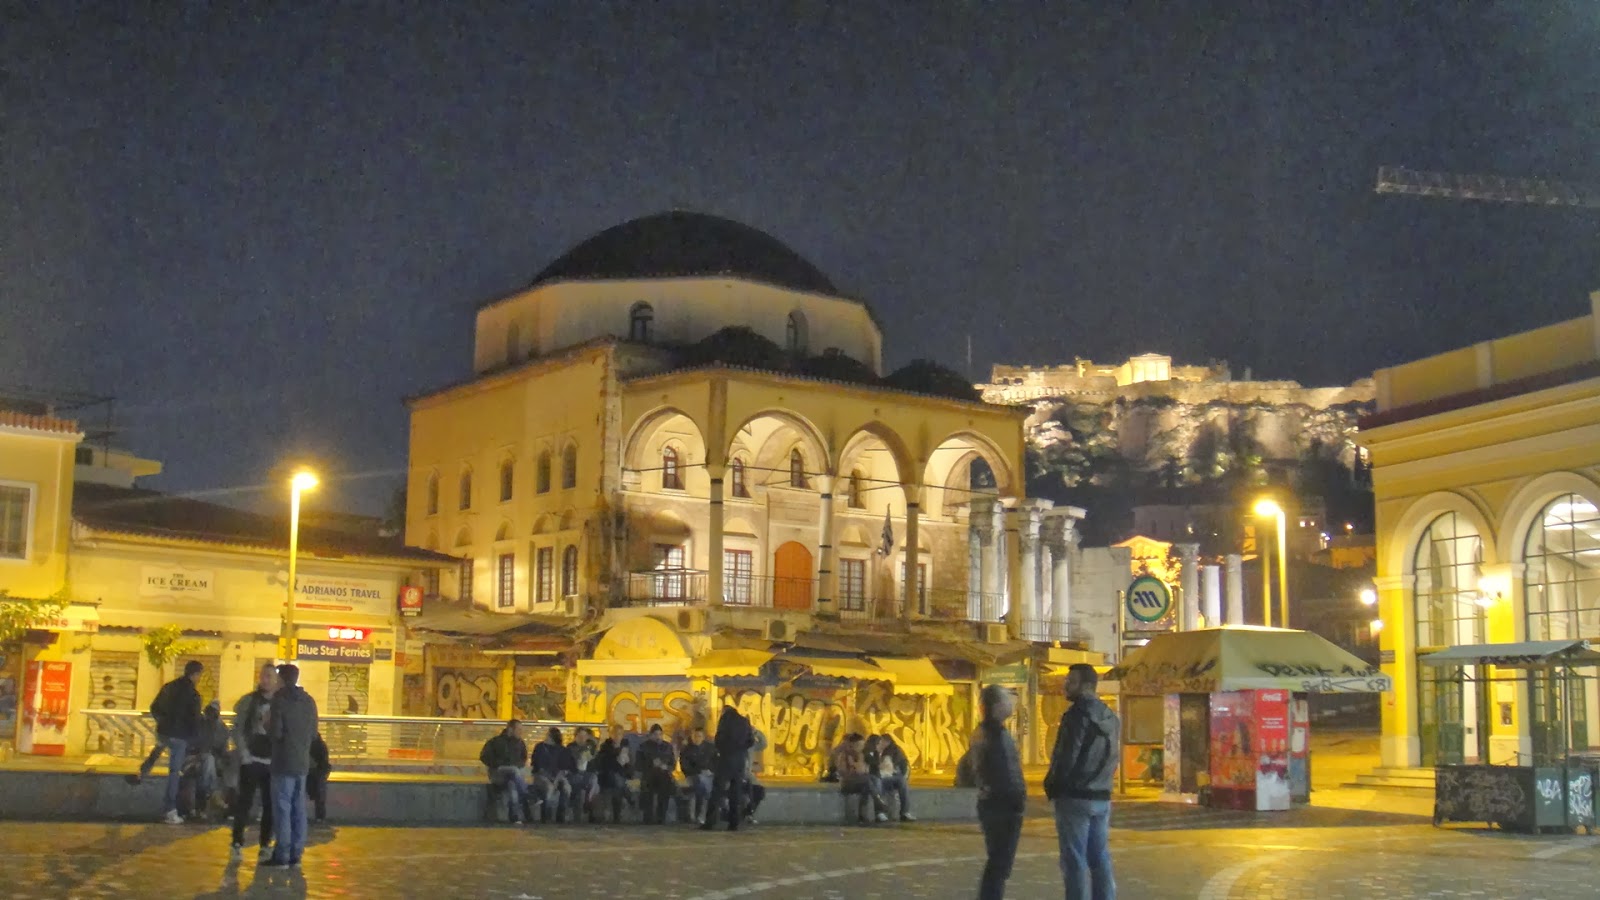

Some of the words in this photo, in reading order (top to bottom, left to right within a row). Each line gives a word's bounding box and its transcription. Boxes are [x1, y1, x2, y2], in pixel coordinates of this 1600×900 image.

[147, 576, 167, 586] ICE
[169, 579, 208, 588] CREAM
[301, 585, 348, 597] ADRIANOS
[350, 588, 382, 600] TRAVEL
[298, 644, 319, 656] Blue
[320, 645, 339, 657] Star
[340, 646, 371, 658] Ferries
